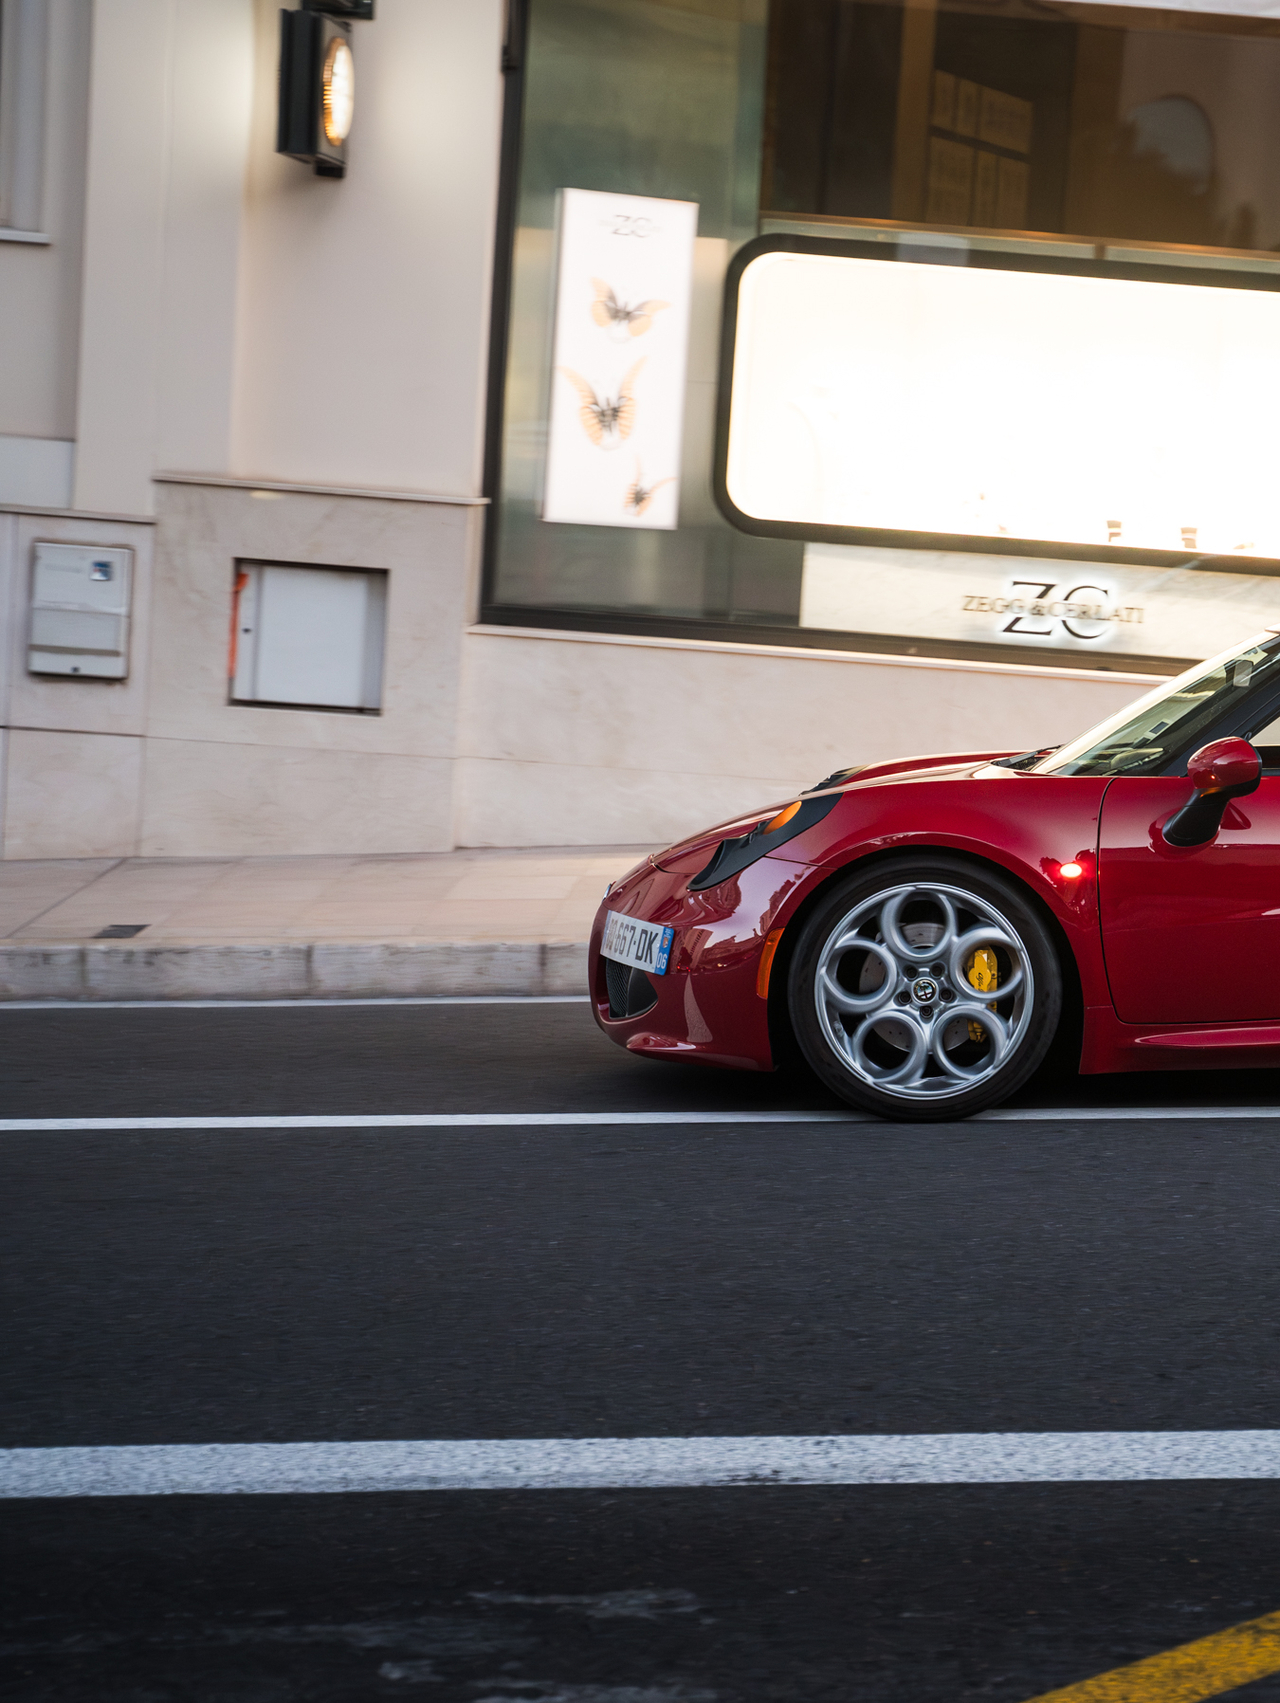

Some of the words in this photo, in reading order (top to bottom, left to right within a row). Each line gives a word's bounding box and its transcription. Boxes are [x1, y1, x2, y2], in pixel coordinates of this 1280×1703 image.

[962, 595, 1024, 614] ZEGG
[1029, 601, 1045, 616] &
[1049, 602, 1145, 623] CERLATI
[1002, 581, 1109, 639] ZC
[656, 952, 668, 970] 06
